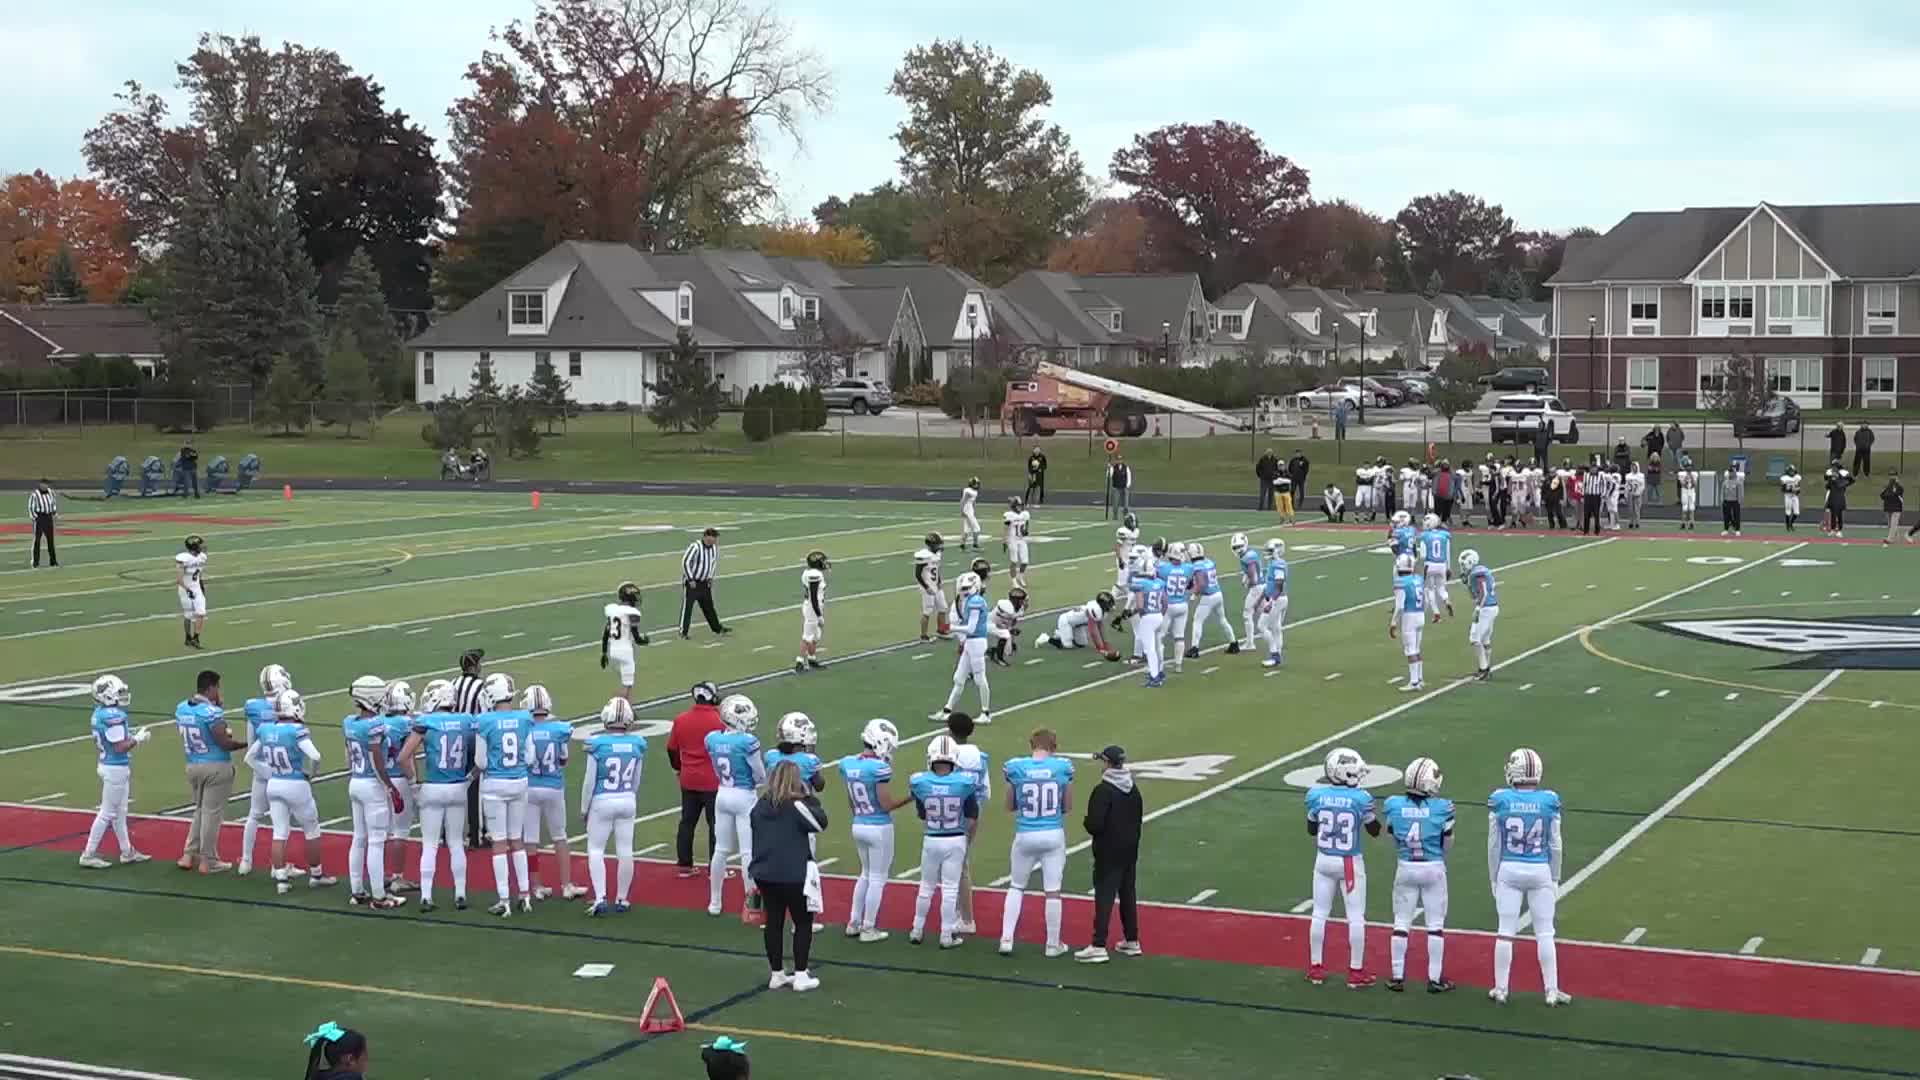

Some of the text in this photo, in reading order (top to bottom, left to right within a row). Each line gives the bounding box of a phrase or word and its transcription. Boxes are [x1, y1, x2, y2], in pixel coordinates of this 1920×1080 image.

[1167, 574, 1187, 597] 55
[438, 733, 464, 770] 14
[501, 731, 519, 768] 9
[603, 756, 638, 791] 34
[924, 796, 962, 830] 25
[1021, 781, 1059, 819] 30
[1317, 810, 1356, 850] 23
[1405, 821, 1424, 857] 4
[1505, 816, 1544, 855] 24
